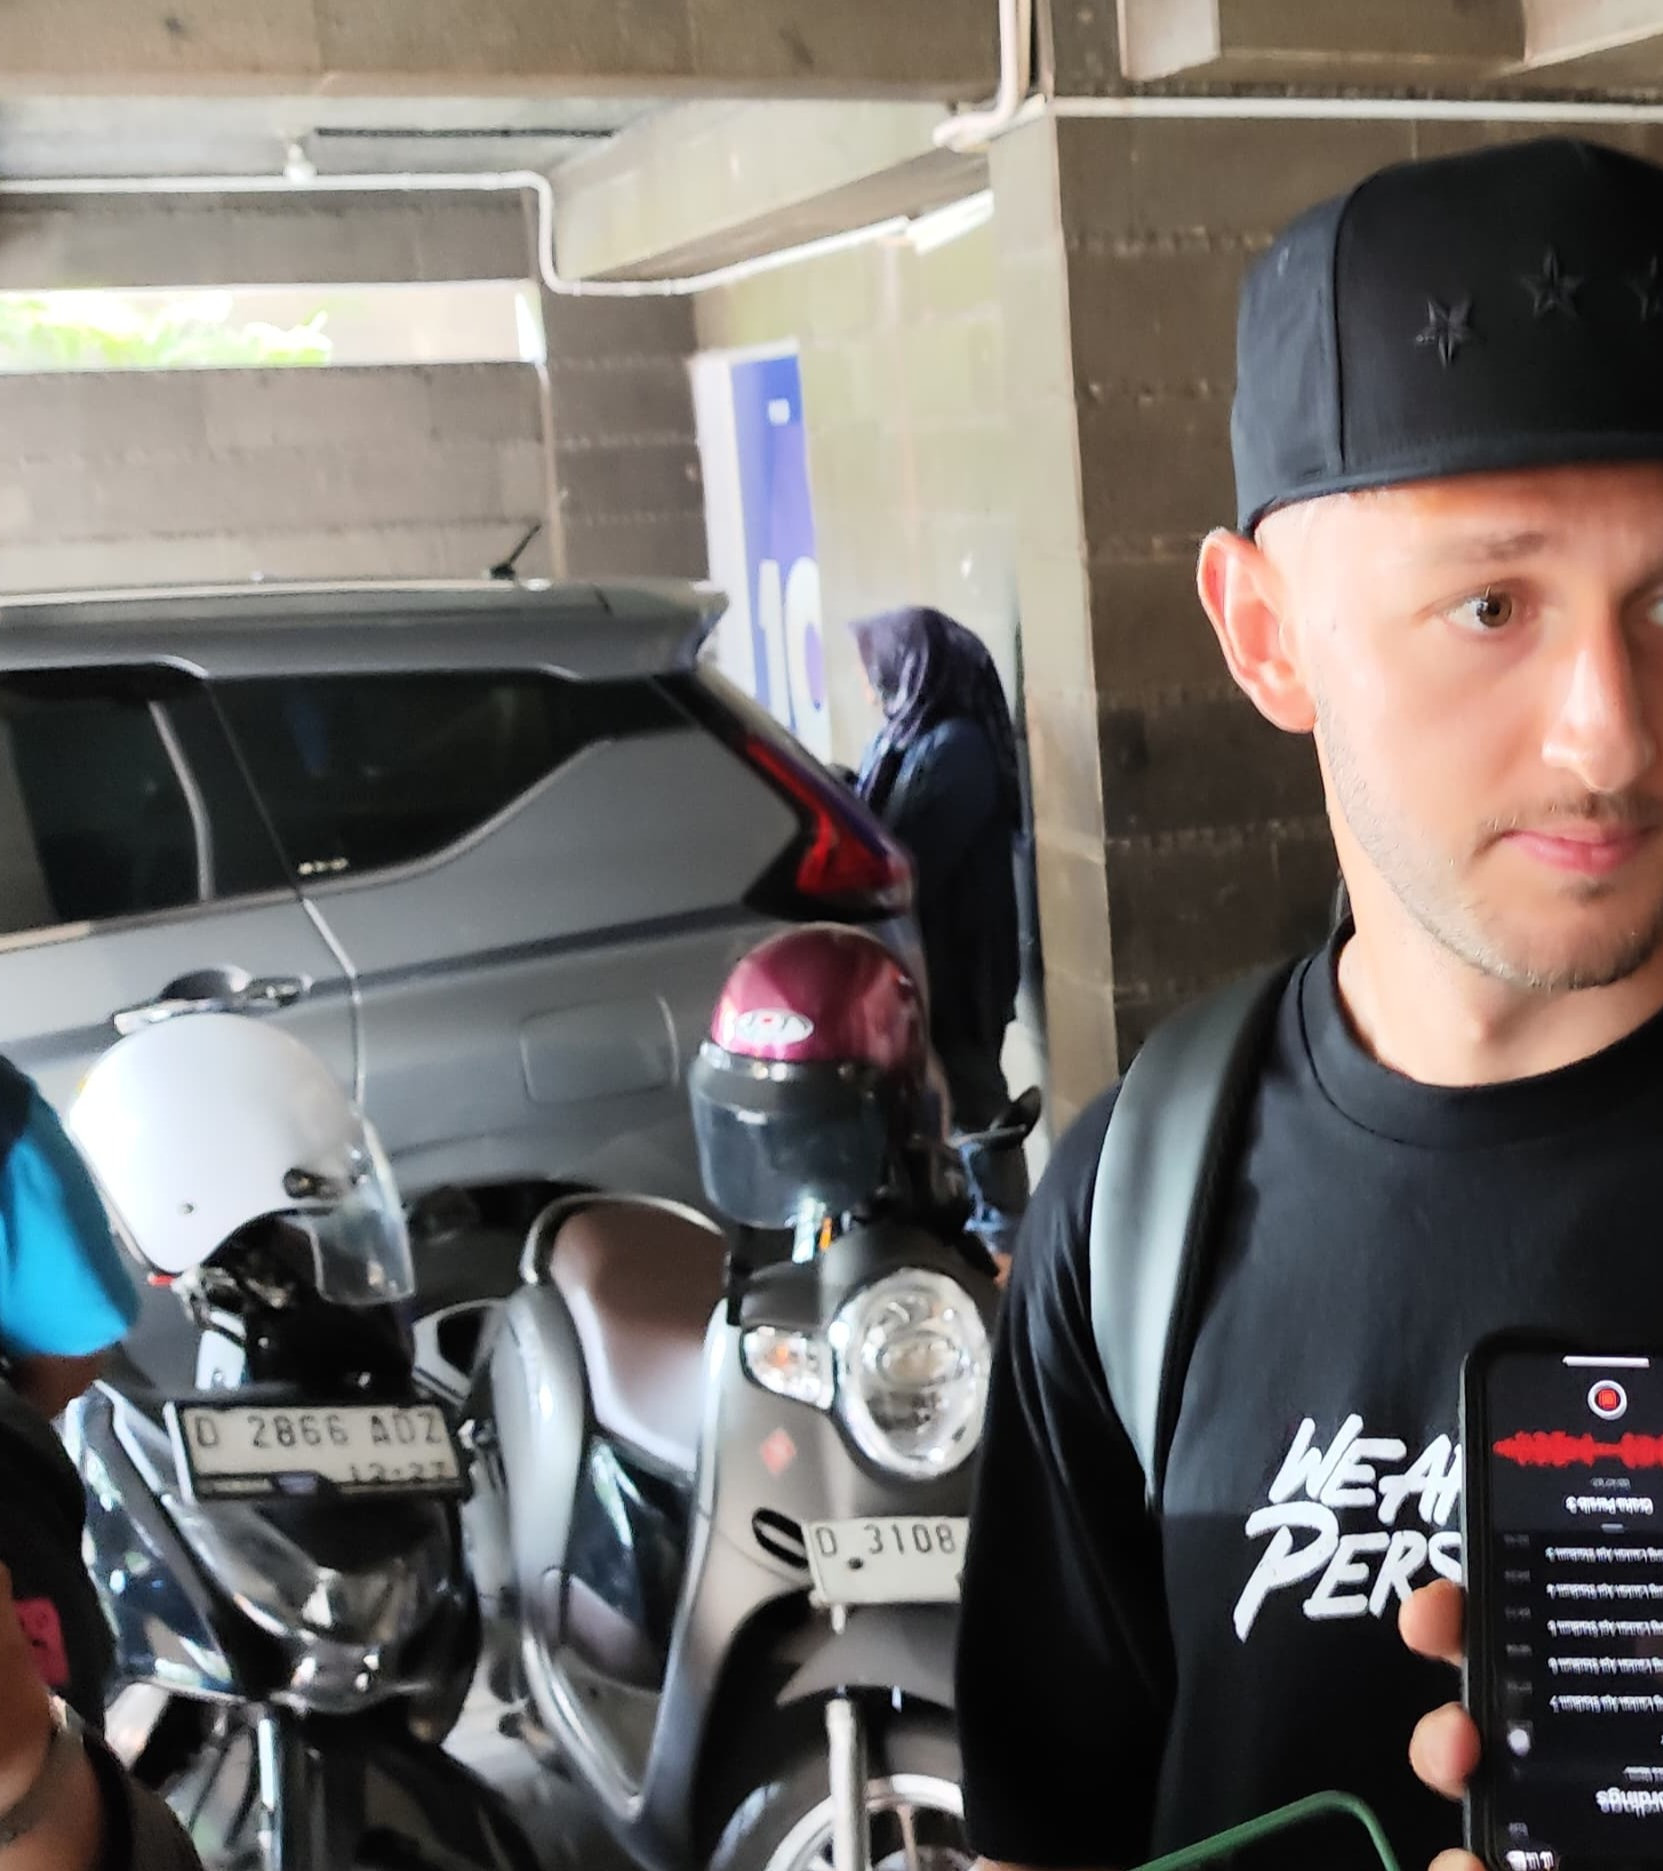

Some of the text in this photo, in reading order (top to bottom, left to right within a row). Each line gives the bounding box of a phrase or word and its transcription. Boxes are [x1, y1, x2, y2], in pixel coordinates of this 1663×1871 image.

[195, 1410, 442, 1448] D 2866 ADZ
[1378, 1433, 1463, 1526] A
[816, 1524, 955, 1556] D 3108
